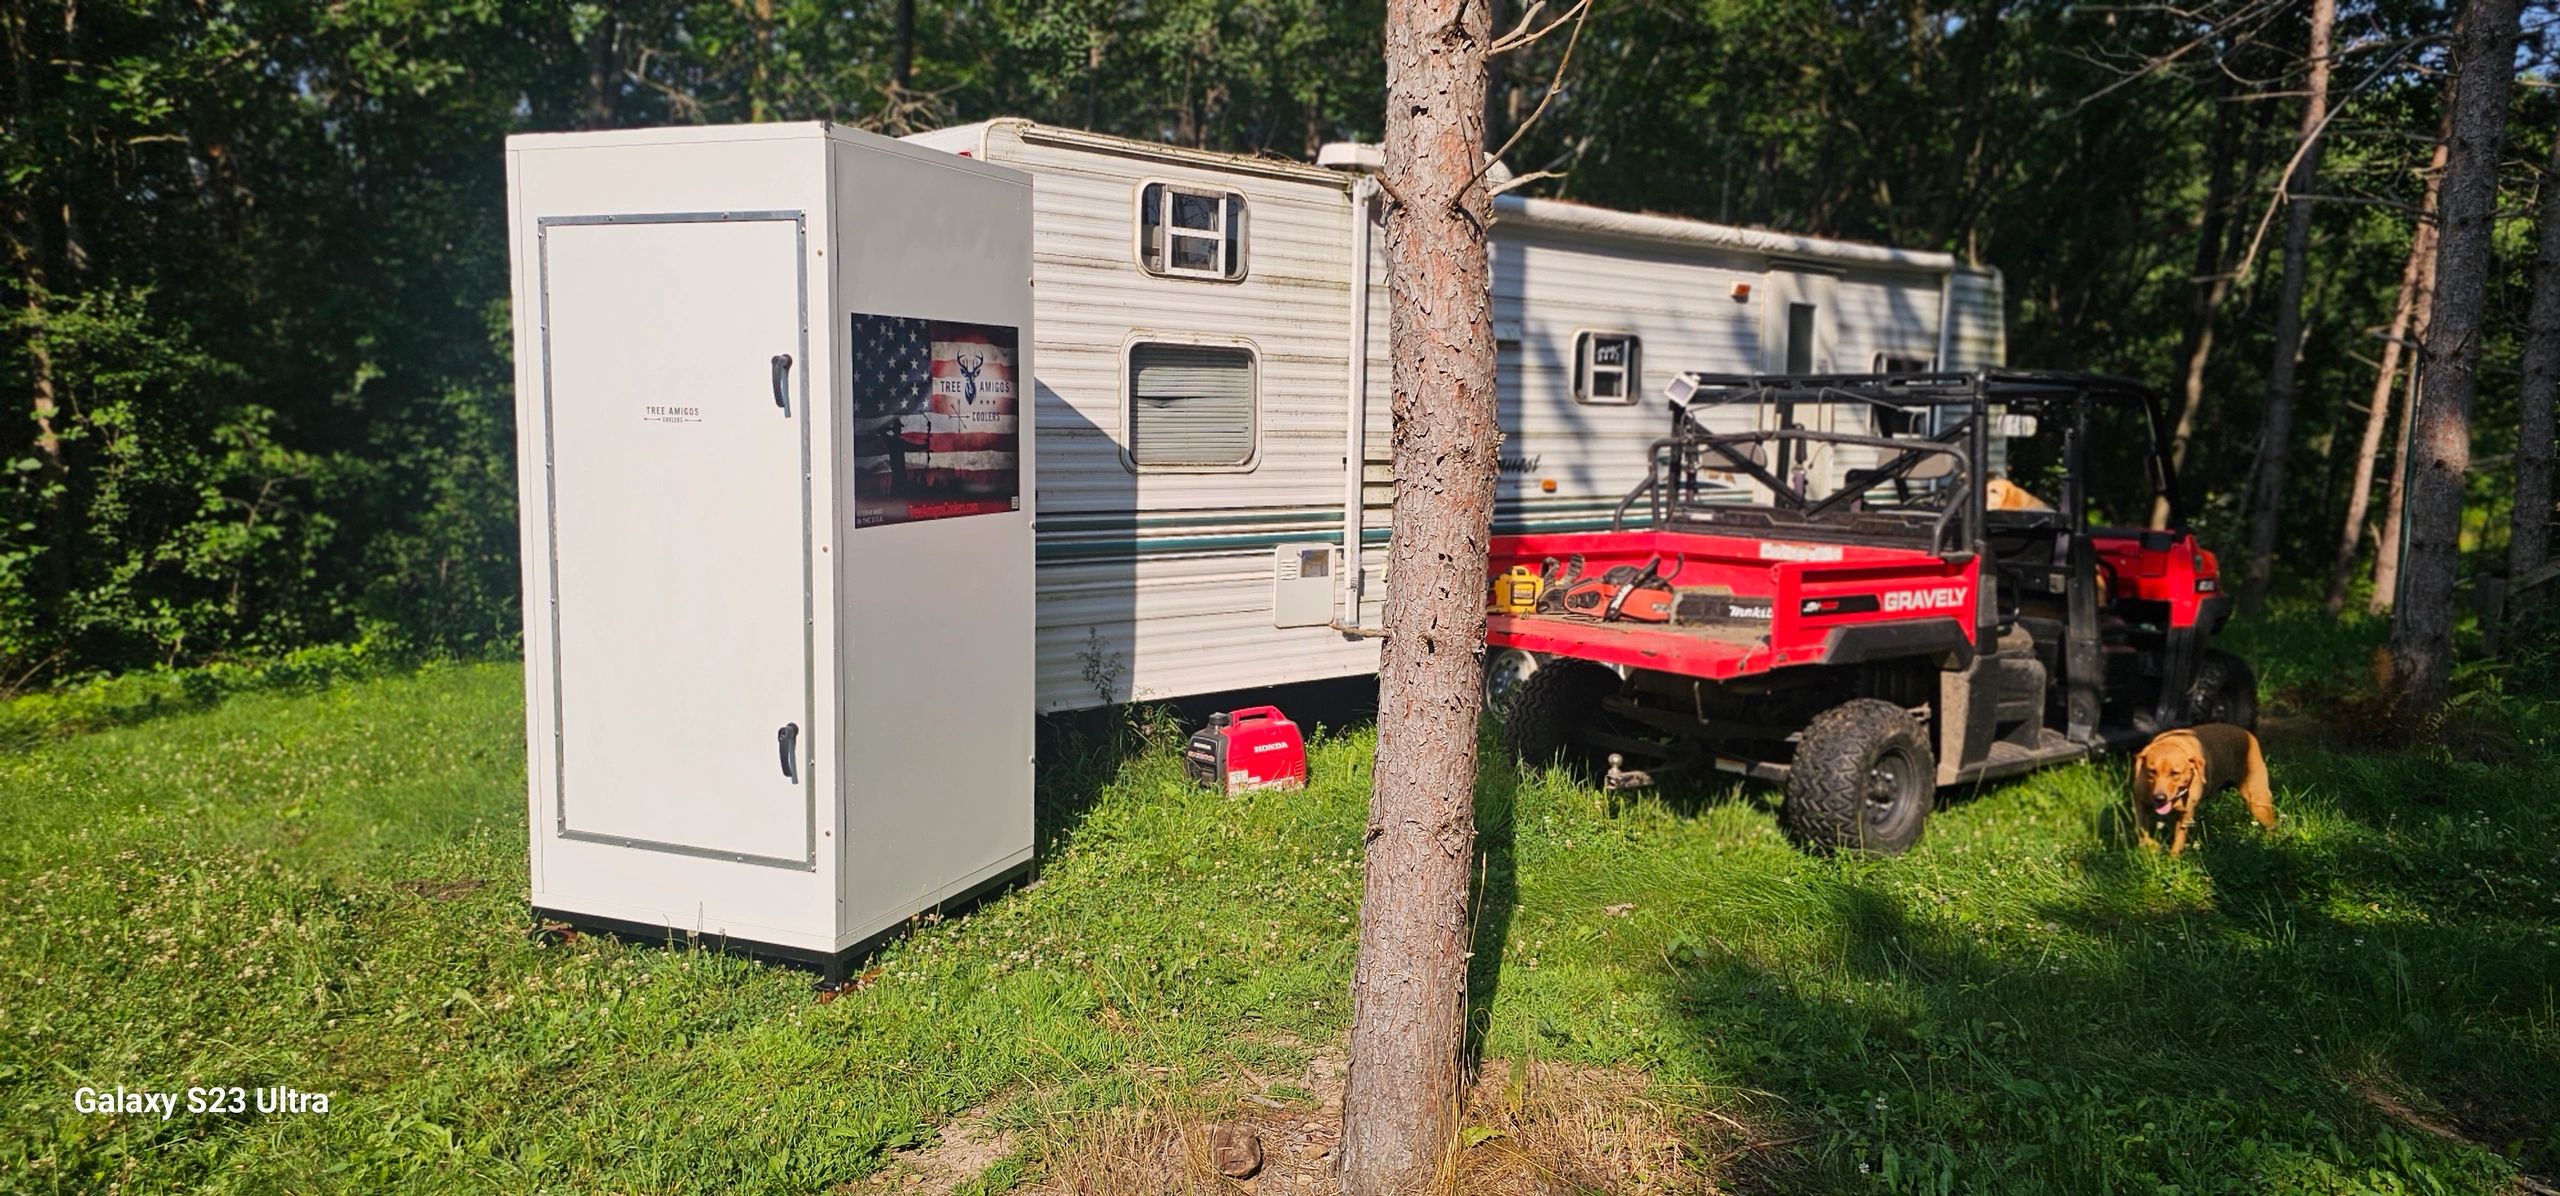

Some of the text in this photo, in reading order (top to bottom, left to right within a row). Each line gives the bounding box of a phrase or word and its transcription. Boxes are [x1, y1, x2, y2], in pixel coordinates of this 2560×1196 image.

[940, 380, 1010, 393] TREE AMIGOS
[646, 406, 700, 416] TREE AMIGOS
[972, 411, 1001, 422] COOLERS
[1884, 588, 1968, 611] GRAVELY
[1254, 741, 1288, 753] HONDA
